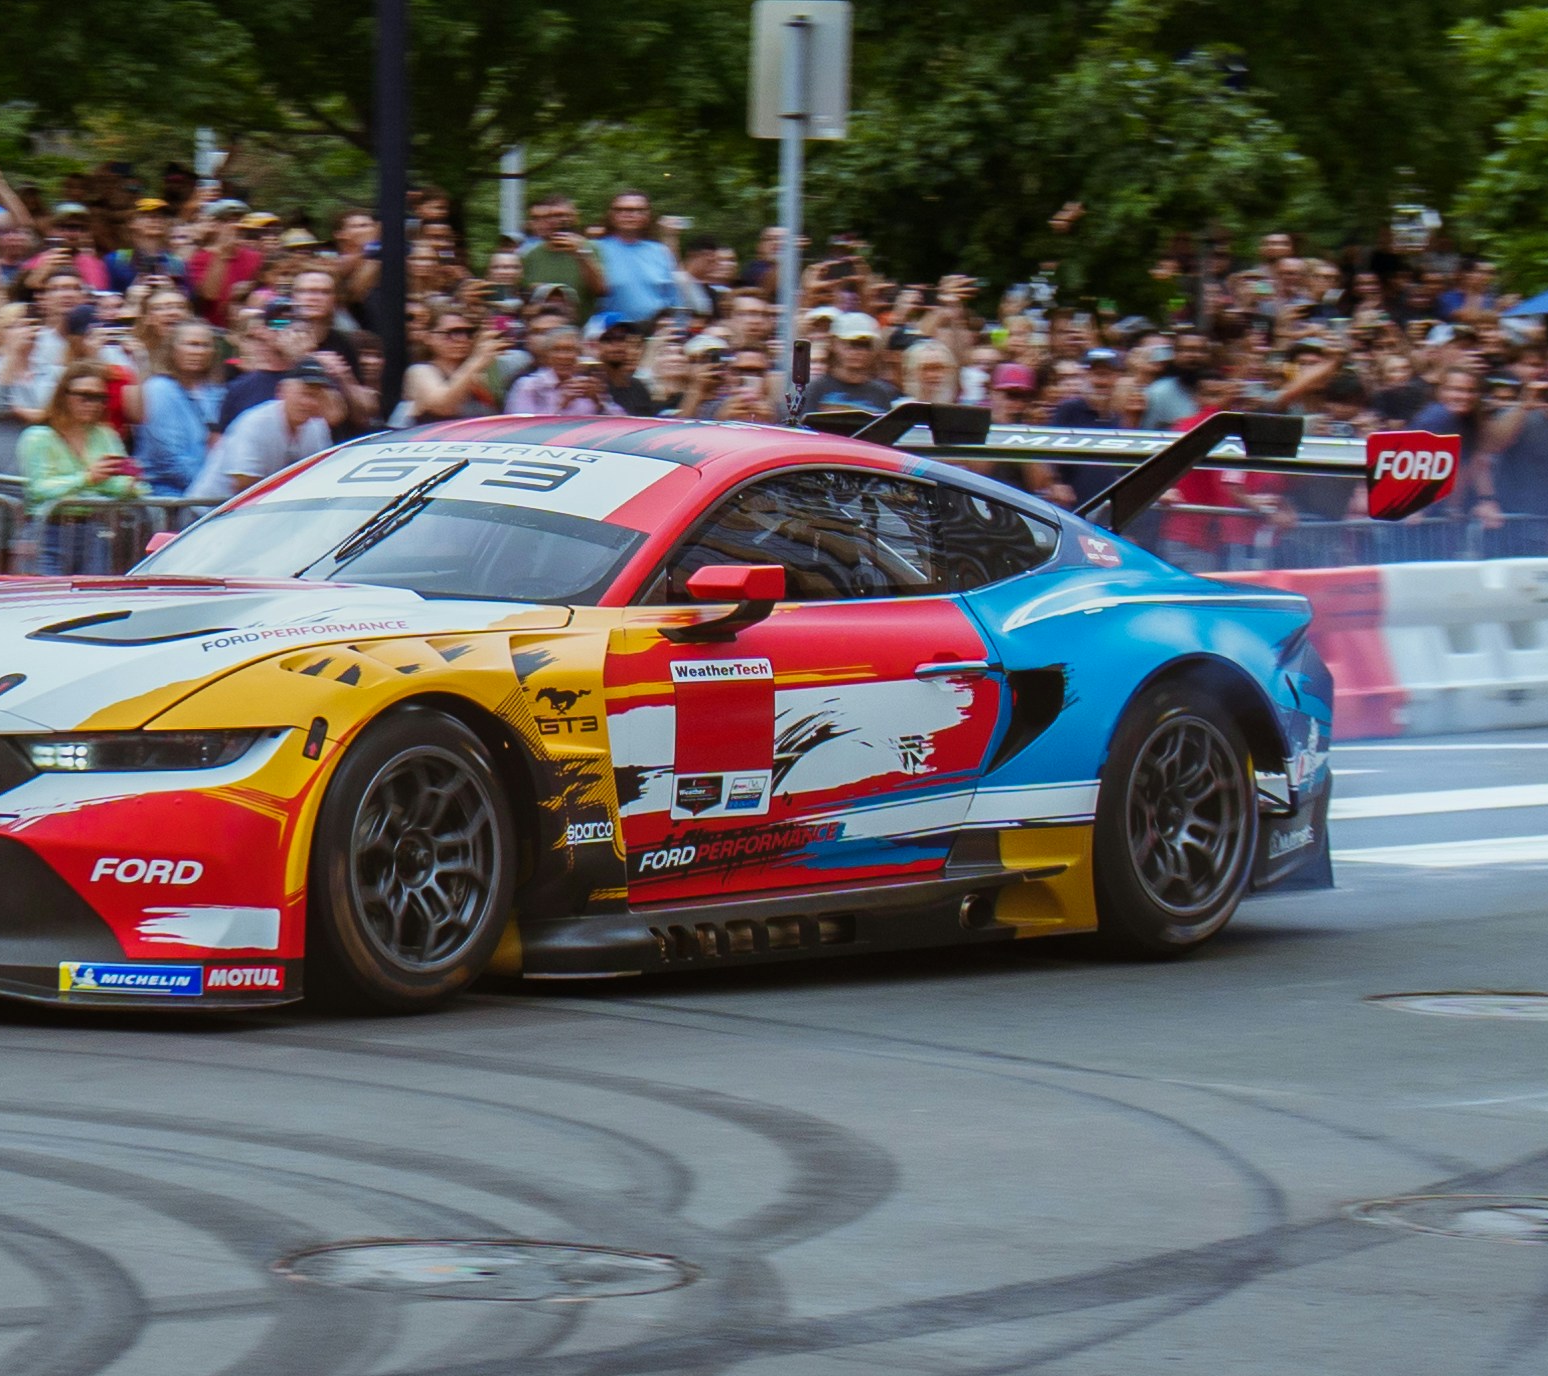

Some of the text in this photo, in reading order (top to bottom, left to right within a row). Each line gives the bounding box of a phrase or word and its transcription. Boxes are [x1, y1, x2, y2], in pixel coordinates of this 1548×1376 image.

[377, 445, 603, 464] MUSTANG
[1372, 450, 1455, 480] FORD
[336, 456, 582, 493] GT3
[675, 661, 768, 679] WeatherTech
[536, 714, 599, 736] GT3
[566, 821, 614, 844] sparco
[90, 857, 204, 886] FORD
[100, 972, 192, 988] MICHELIN
[207, 968, 280, 987] MOTUL
